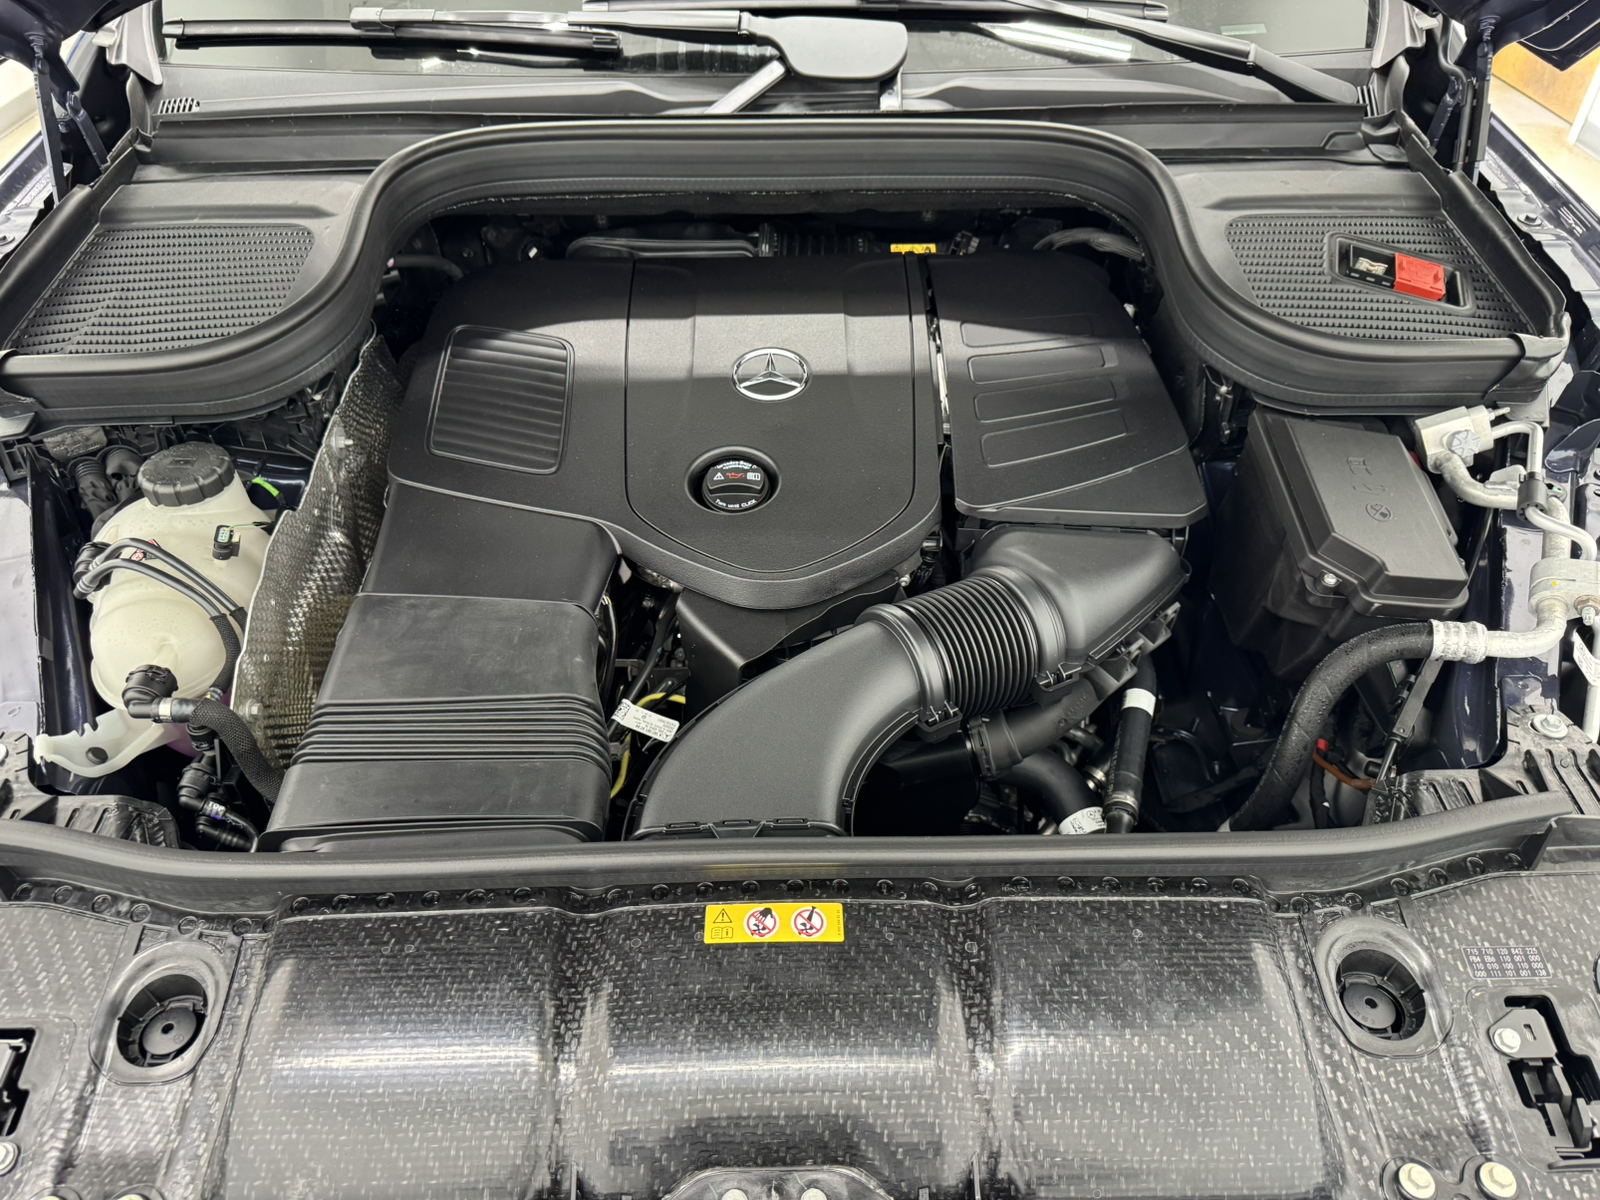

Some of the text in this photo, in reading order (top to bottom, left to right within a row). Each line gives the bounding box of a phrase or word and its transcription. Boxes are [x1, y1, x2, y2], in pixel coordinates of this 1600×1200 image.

[716, 498, 726, 506] Turn
[741, 498, 756, 508] CLICK
[208, 800, 226, 812] TOP
